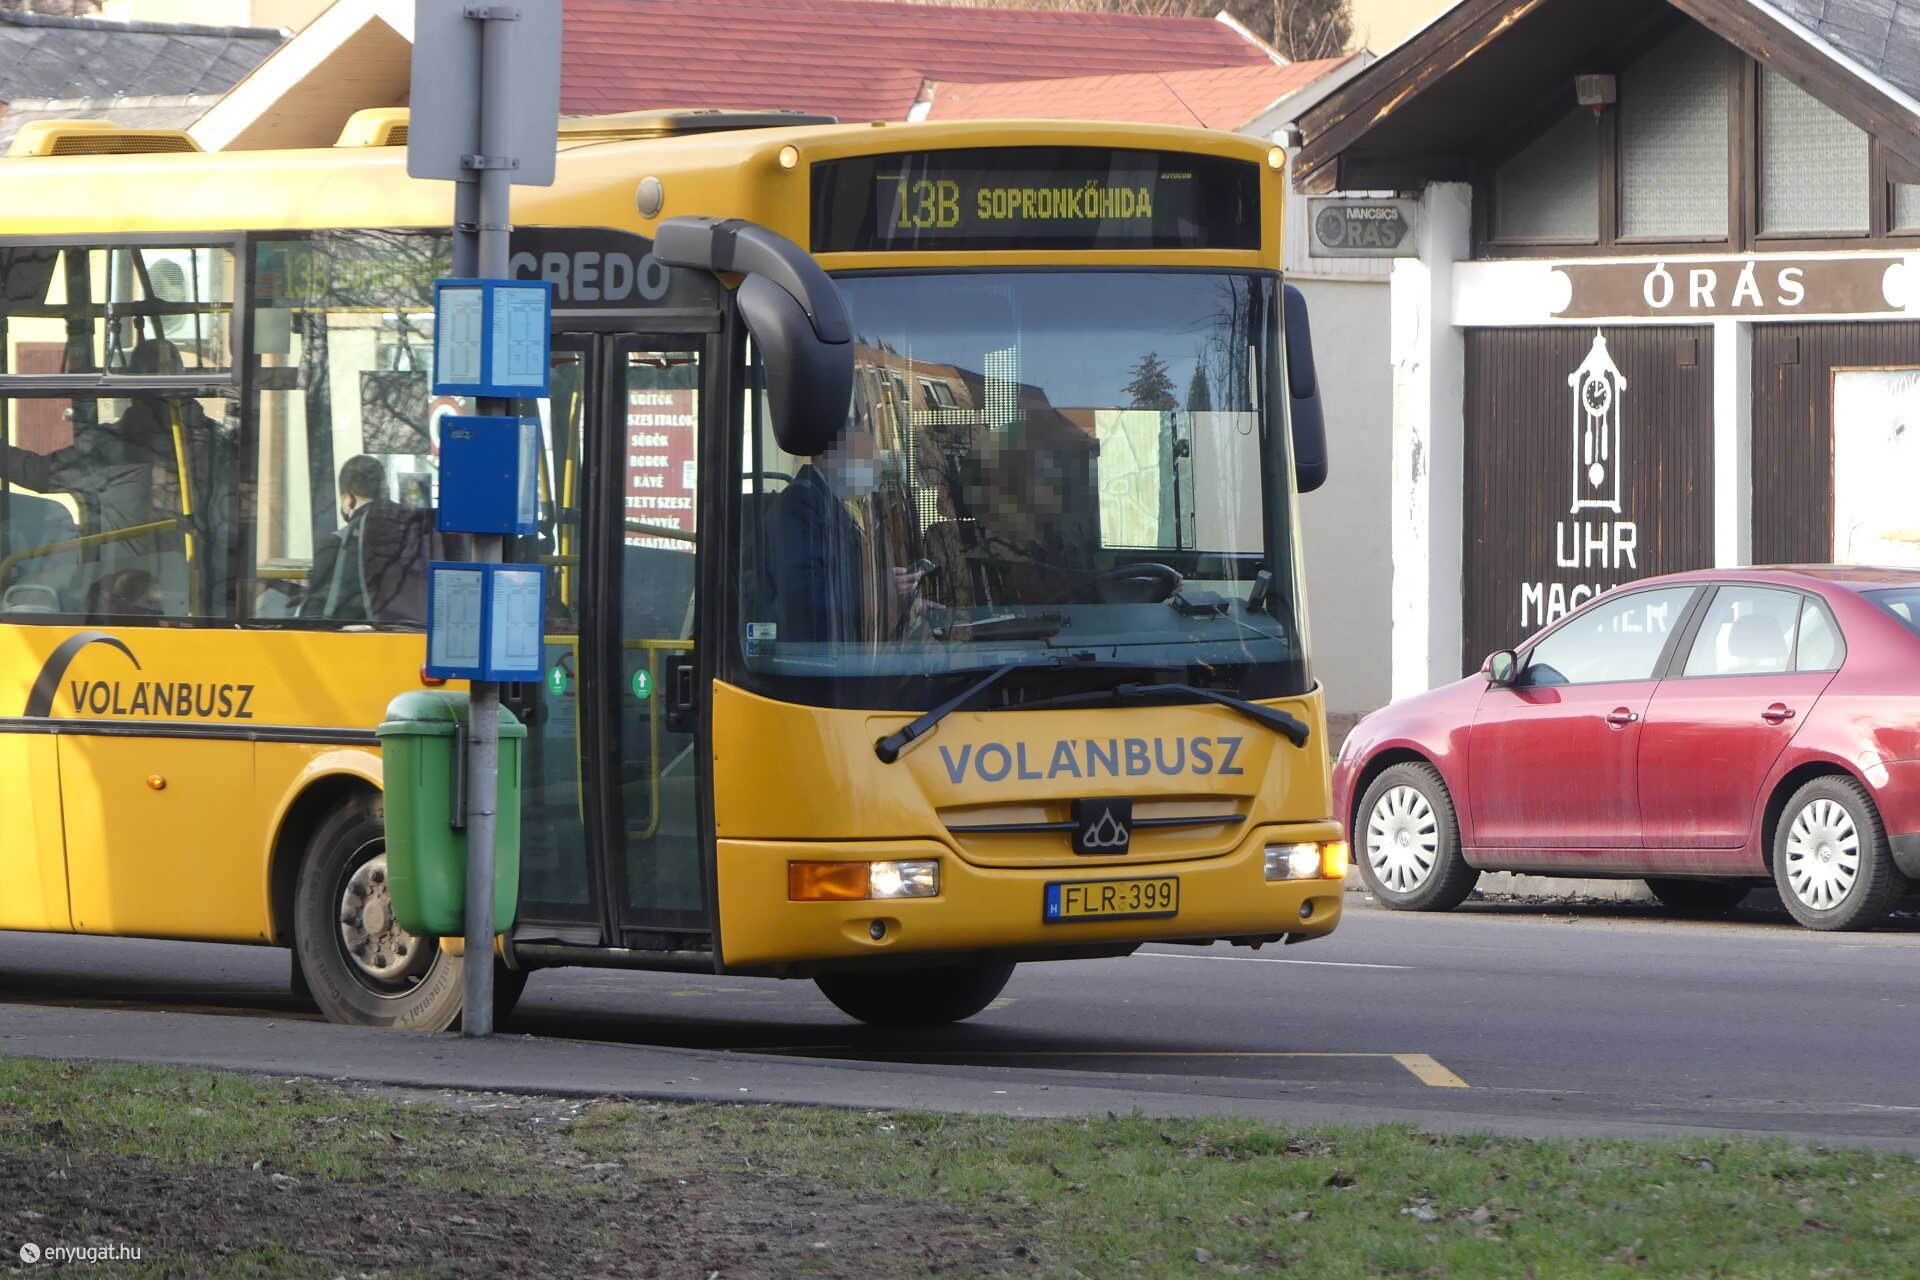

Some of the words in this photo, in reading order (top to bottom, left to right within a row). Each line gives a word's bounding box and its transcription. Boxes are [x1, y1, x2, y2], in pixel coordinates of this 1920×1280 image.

[897, 180, 960, 228] 13B
[977, 179, 1152, 219] SOPRONKŐHIDA
[1346, 207, 1399, 220] IVANCSICS
[509, 252, 671, 301] CREDO
[1643, 261, 1805, 309] ÓRÁS
[1556, 521, 1637, 569] UHR
[1521, 582, 1668, 633] MACER
[71, 681, 255, 718] VOLÁNBUSZ
[939, 737, 1244, 784] VOLÁNBUSZ
[1066, 882, 1171, 913] FLR-399
